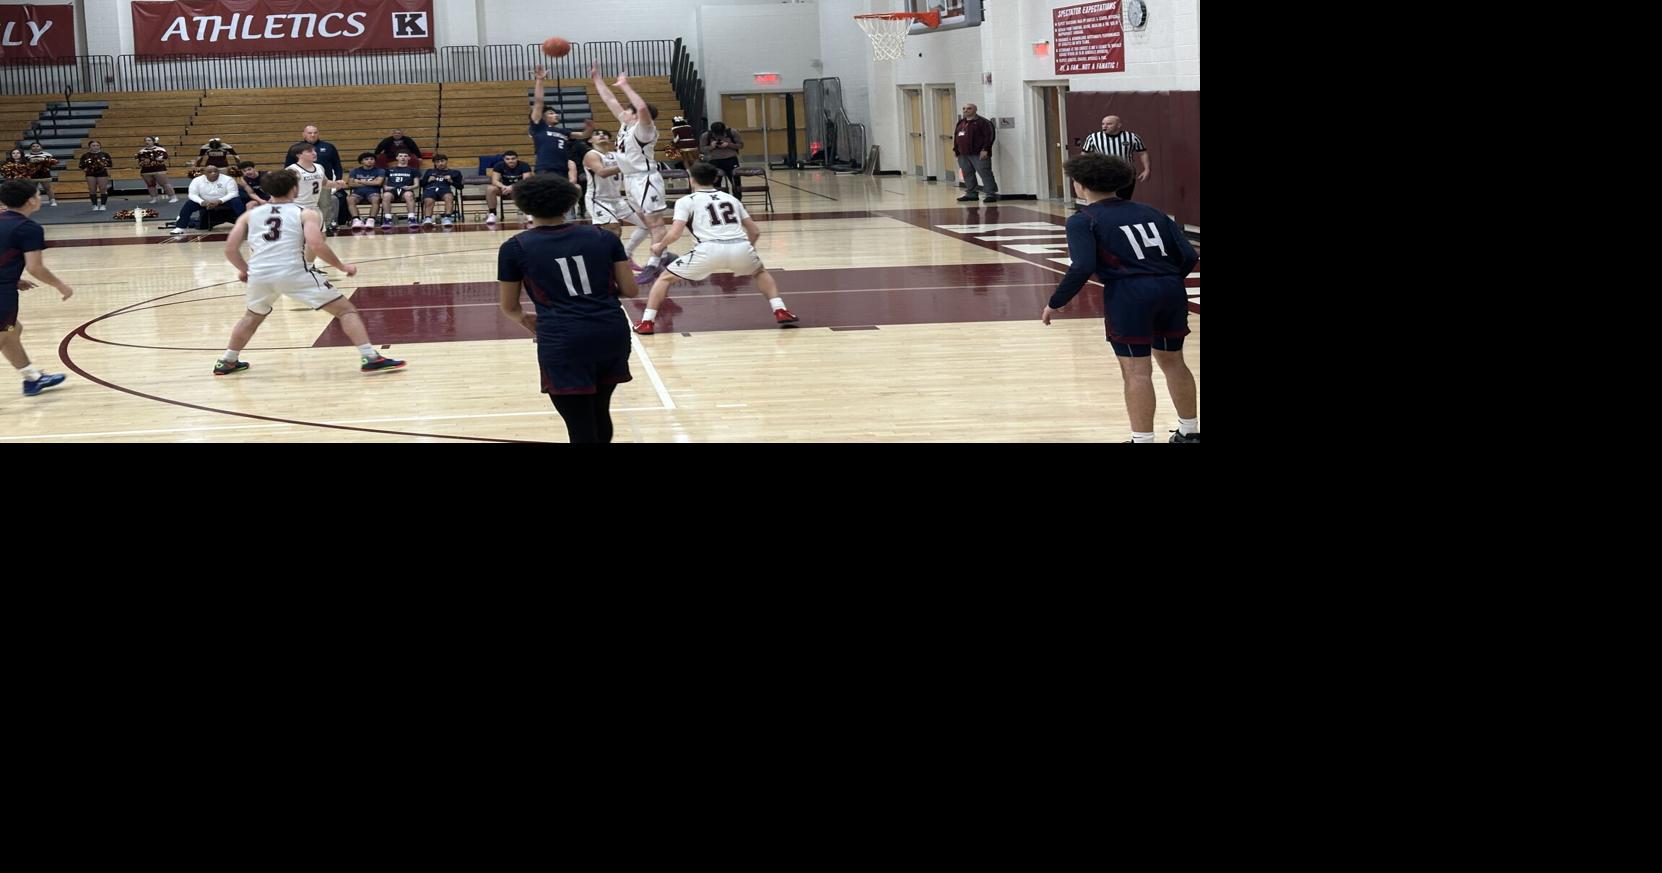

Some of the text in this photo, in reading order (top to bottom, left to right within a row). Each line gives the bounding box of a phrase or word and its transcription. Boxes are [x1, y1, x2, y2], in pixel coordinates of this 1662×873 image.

[2, 20, 53, 47] LY
[161, 12, 367, 42] ATHLETICS
[394, 13, 427, 36] K
[558, 139, 564, 149] 2
[312, 180, 319, 195] 2
[271, 206, 282, 214] K
[706, 201, 738, 227] 12
[262, 217, 283, 241] 3
[1119, 222, 1168, 260] 14
[554, 255, 592, 297] 11
